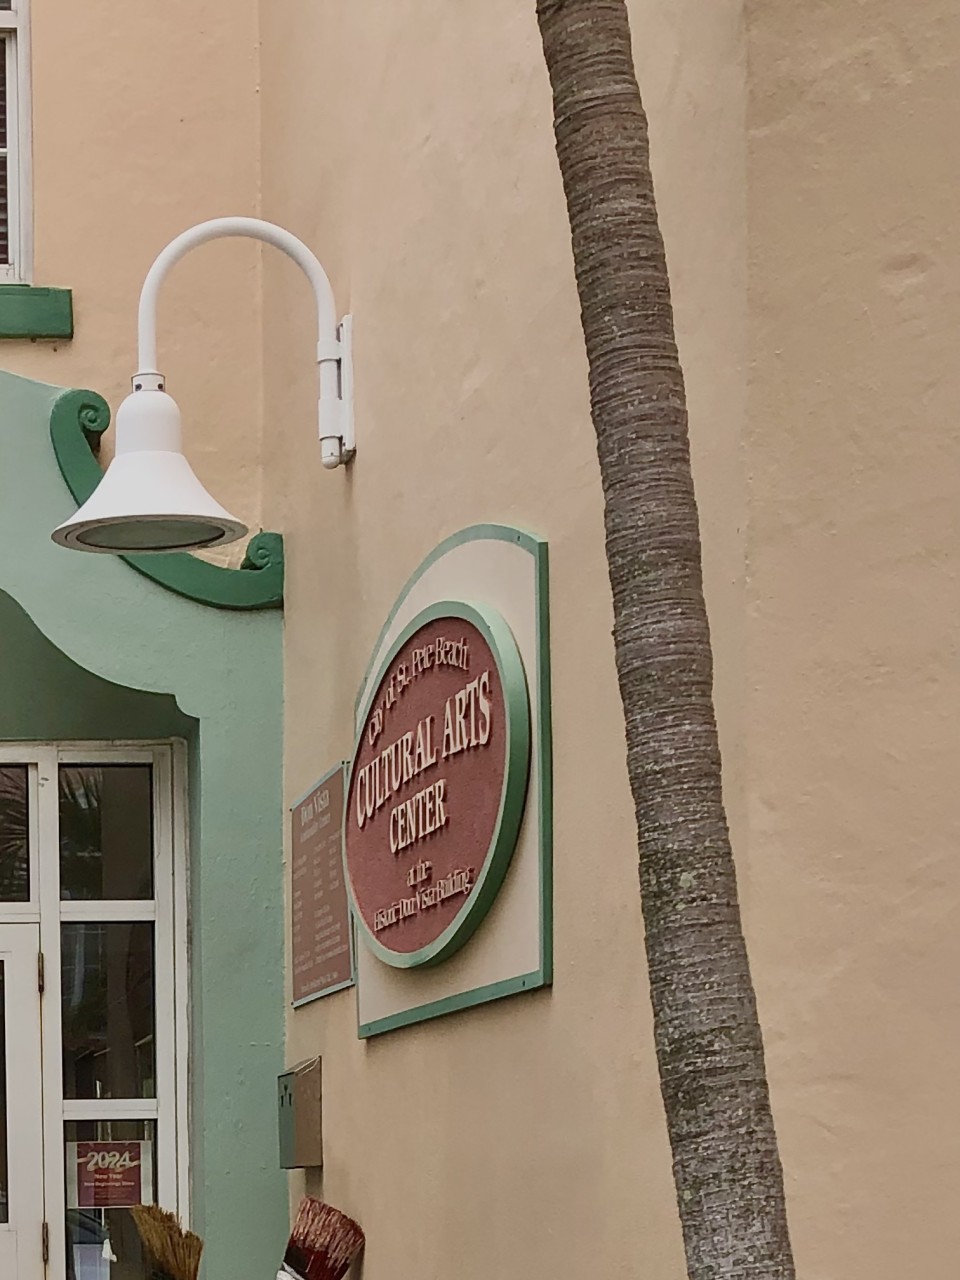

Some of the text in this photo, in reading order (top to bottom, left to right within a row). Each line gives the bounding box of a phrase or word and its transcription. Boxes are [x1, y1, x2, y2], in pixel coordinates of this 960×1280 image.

[368, 636, 469, 746] City of St. Pete Beach
[356, 669, 490, 828] CULTURAL ARTS
[390, 778, 450, 854] CENTER
[86, 1150, 133, 1172] 2024
